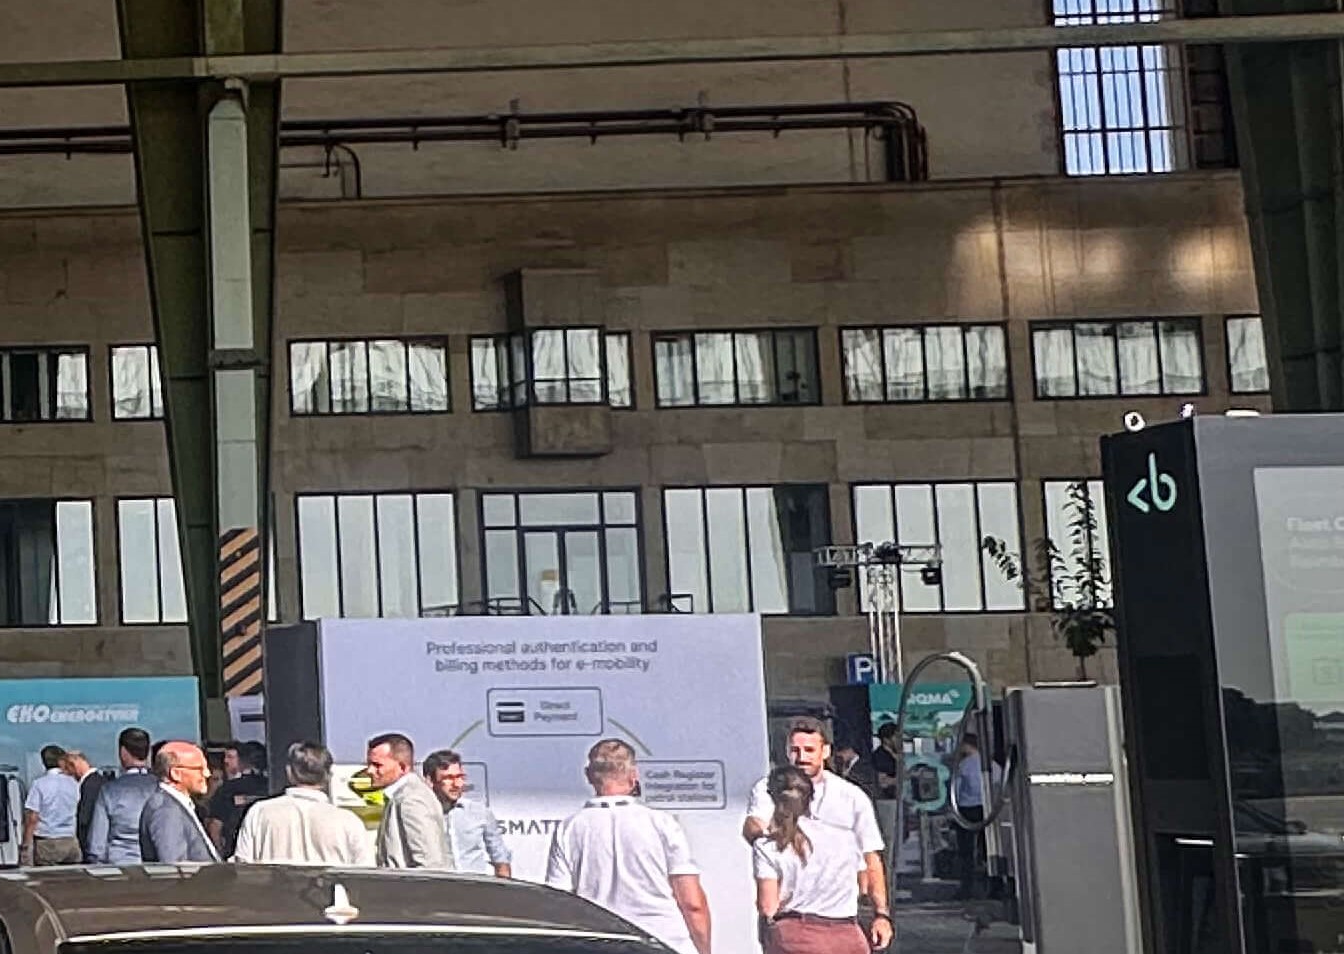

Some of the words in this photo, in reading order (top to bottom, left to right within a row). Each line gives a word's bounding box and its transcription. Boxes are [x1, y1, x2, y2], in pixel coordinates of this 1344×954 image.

[426, 641, 516, 655] Professional
[521, 640, 625, 653] authentication
[630, 640, 658, 653] and
[435, 658, 478, 674] billing
[482, 658, 546, 671] methods
[551, 657, 571, 670] for
[576, 657, 650, 672] e-mobility
[855, 657, 873, 682] P
